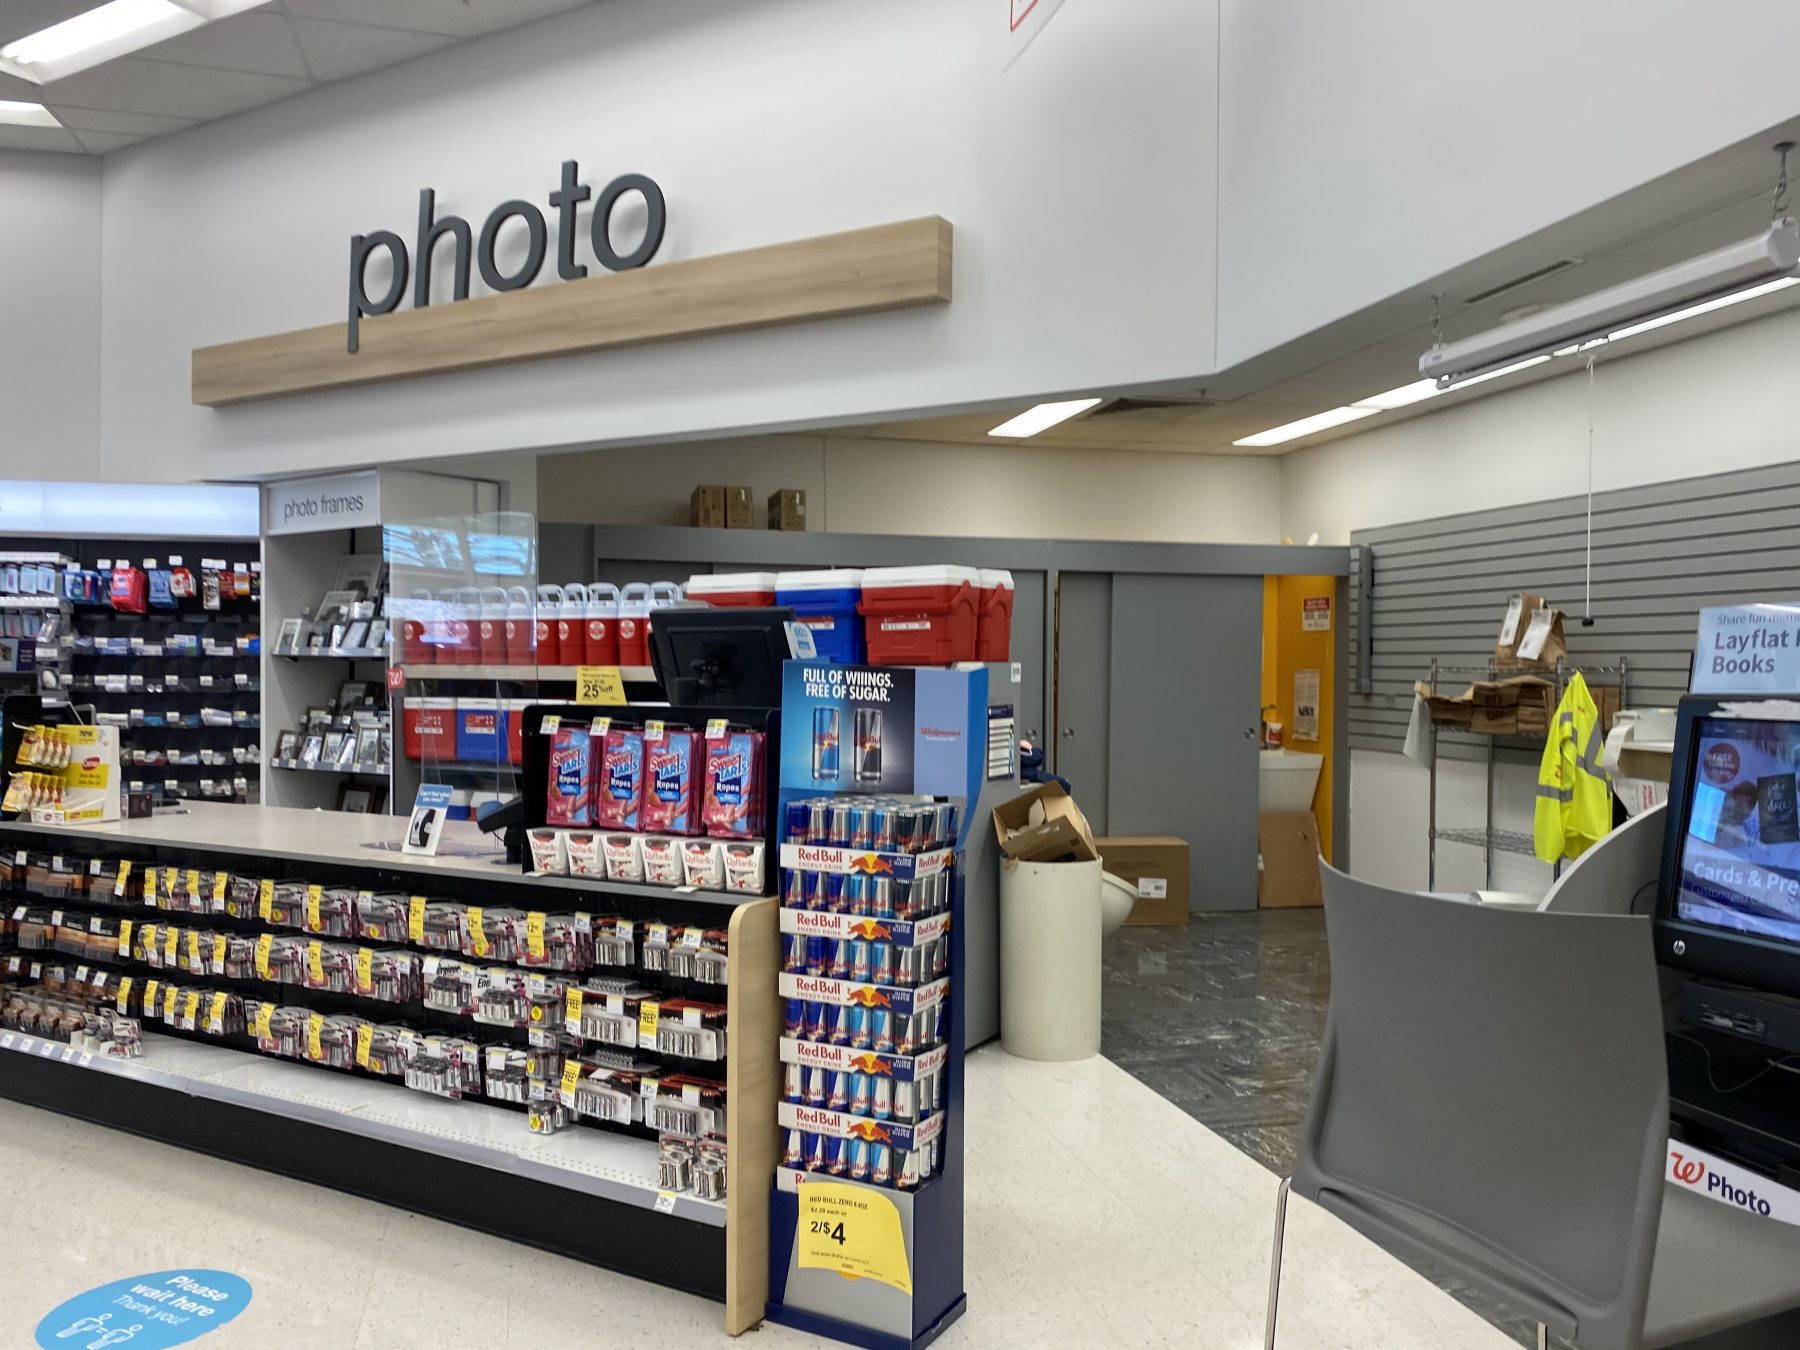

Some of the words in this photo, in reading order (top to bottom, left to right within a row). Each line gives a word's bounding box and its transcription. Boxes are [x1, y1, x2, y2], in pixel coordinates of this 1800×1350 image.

[347, 160, 666, 353] photo
[284, 497, 318, 523] photo
[321, 494, 364, 514] frames
[1748, 612, 1766, 624] fun
[1715, 628, 1789, 654] Layflat
[1712, 653, 1775, 674] Books
[803, 668, 826, 683] FULL
[828, 669, 843, 684] OF
[845, 671, 894, 688] WIIINGS.
[806, 683, 829, 697] FREE
[832, 684, 847, 698] OF
[849, 686, 891, 702] SUGAR.
[559, 775, 579, 785] Ropes
[611, 778, 631, 788] Ropes
[656, 780, 679, 790] Ropes
[716, 782, 740, 792] Ropes
[533, 842, 558, 852] Raffaello
[568, 844, 595, 854] Raffaello
[607, 847, 634, 858] Raffaello
[645, 851, 672, 861] Raffaello
[685, 854, 713, 864] Raffaello
[798, 848, 819, 862] Red
[822, 849, 843, 863] Bull
[726, 857, 756, 868] Raffaello
[1694, 862, 1744, 885] Cards
[1748, 870, 1762, 889] &
[797, 912, 818, 926] Red
[819, 914, 841, 928] Bull
[797, 926, 821, 934] ENERGY
[796, 977, 818, 991] Red
[819, 979, 841, 994] Bull
[796, 991, 821, 999] ENERGY
[797, 1043, 819, 1058] Red
[820, 1045, 841, 1060] Bull
[797, 1056, 821, 1064] ENERGY
[796, 1108, 817, 1122] Red
[819, 1110, 841, 1127] Bull
[796, 1121, 820, 1130] ENERGY
[1708, 1171, 1771, 1216] Photo
[823, 1197, 837, 1205] BULL
[838, 1199, 853, 1207] ZERO
[165, 1275, 229, 1302] Please
[130, 1284, 175, 1302] wait
[168, 1296, 215, 1316] here
[112, 1294, 157, 1315] Thank
[147, 1310, 191, 1326] you!
